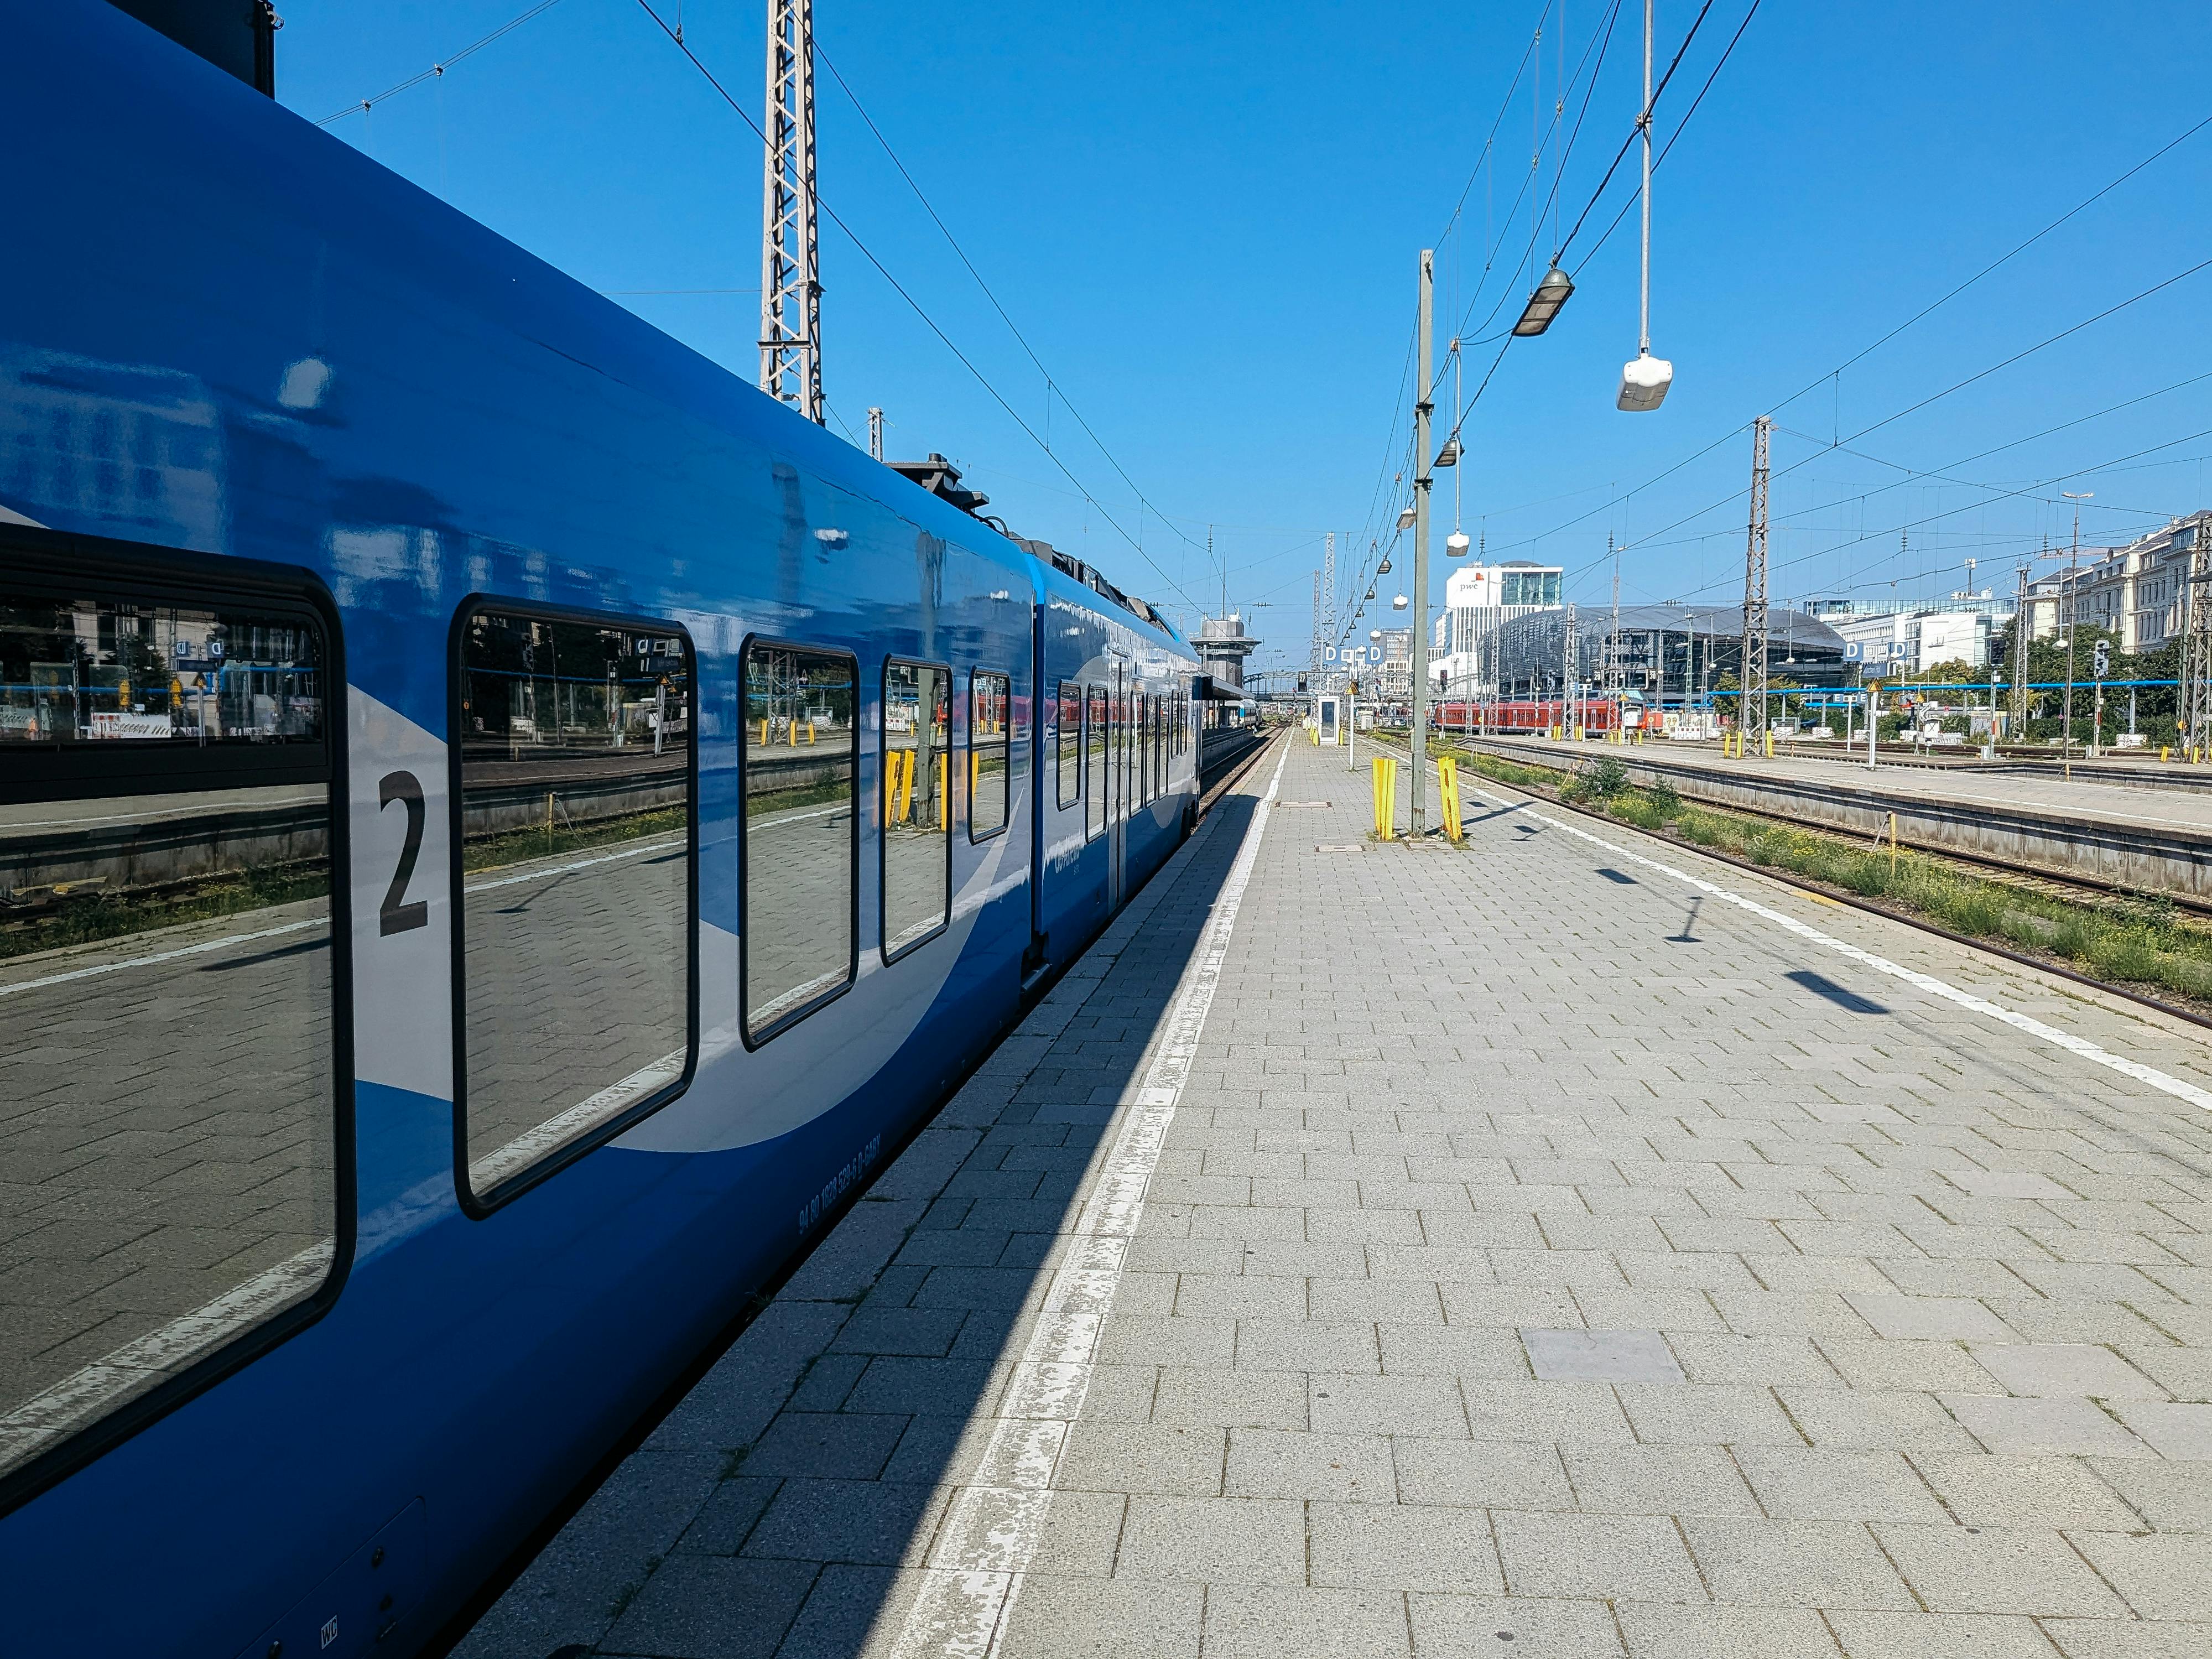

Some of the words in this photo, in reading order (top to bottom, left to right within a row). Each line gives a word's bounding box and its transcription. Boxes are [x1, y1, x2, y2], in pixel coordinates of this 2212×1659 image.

[1326, 647, 1336, 661] D
[1370, 647, 1381, 661] D
[1846, 643, 1858, 658] D
[1894, 642, 1906, 657] D
[1570, 682, 1575, 690] E
[1835, 694, 1841, 702] E
[1860, 694, 1866, 702] E
[379, 770, 428, 938] 2
[799, 1204, 808, 1235] 94
[322, 1619, 337, 1645] WC
